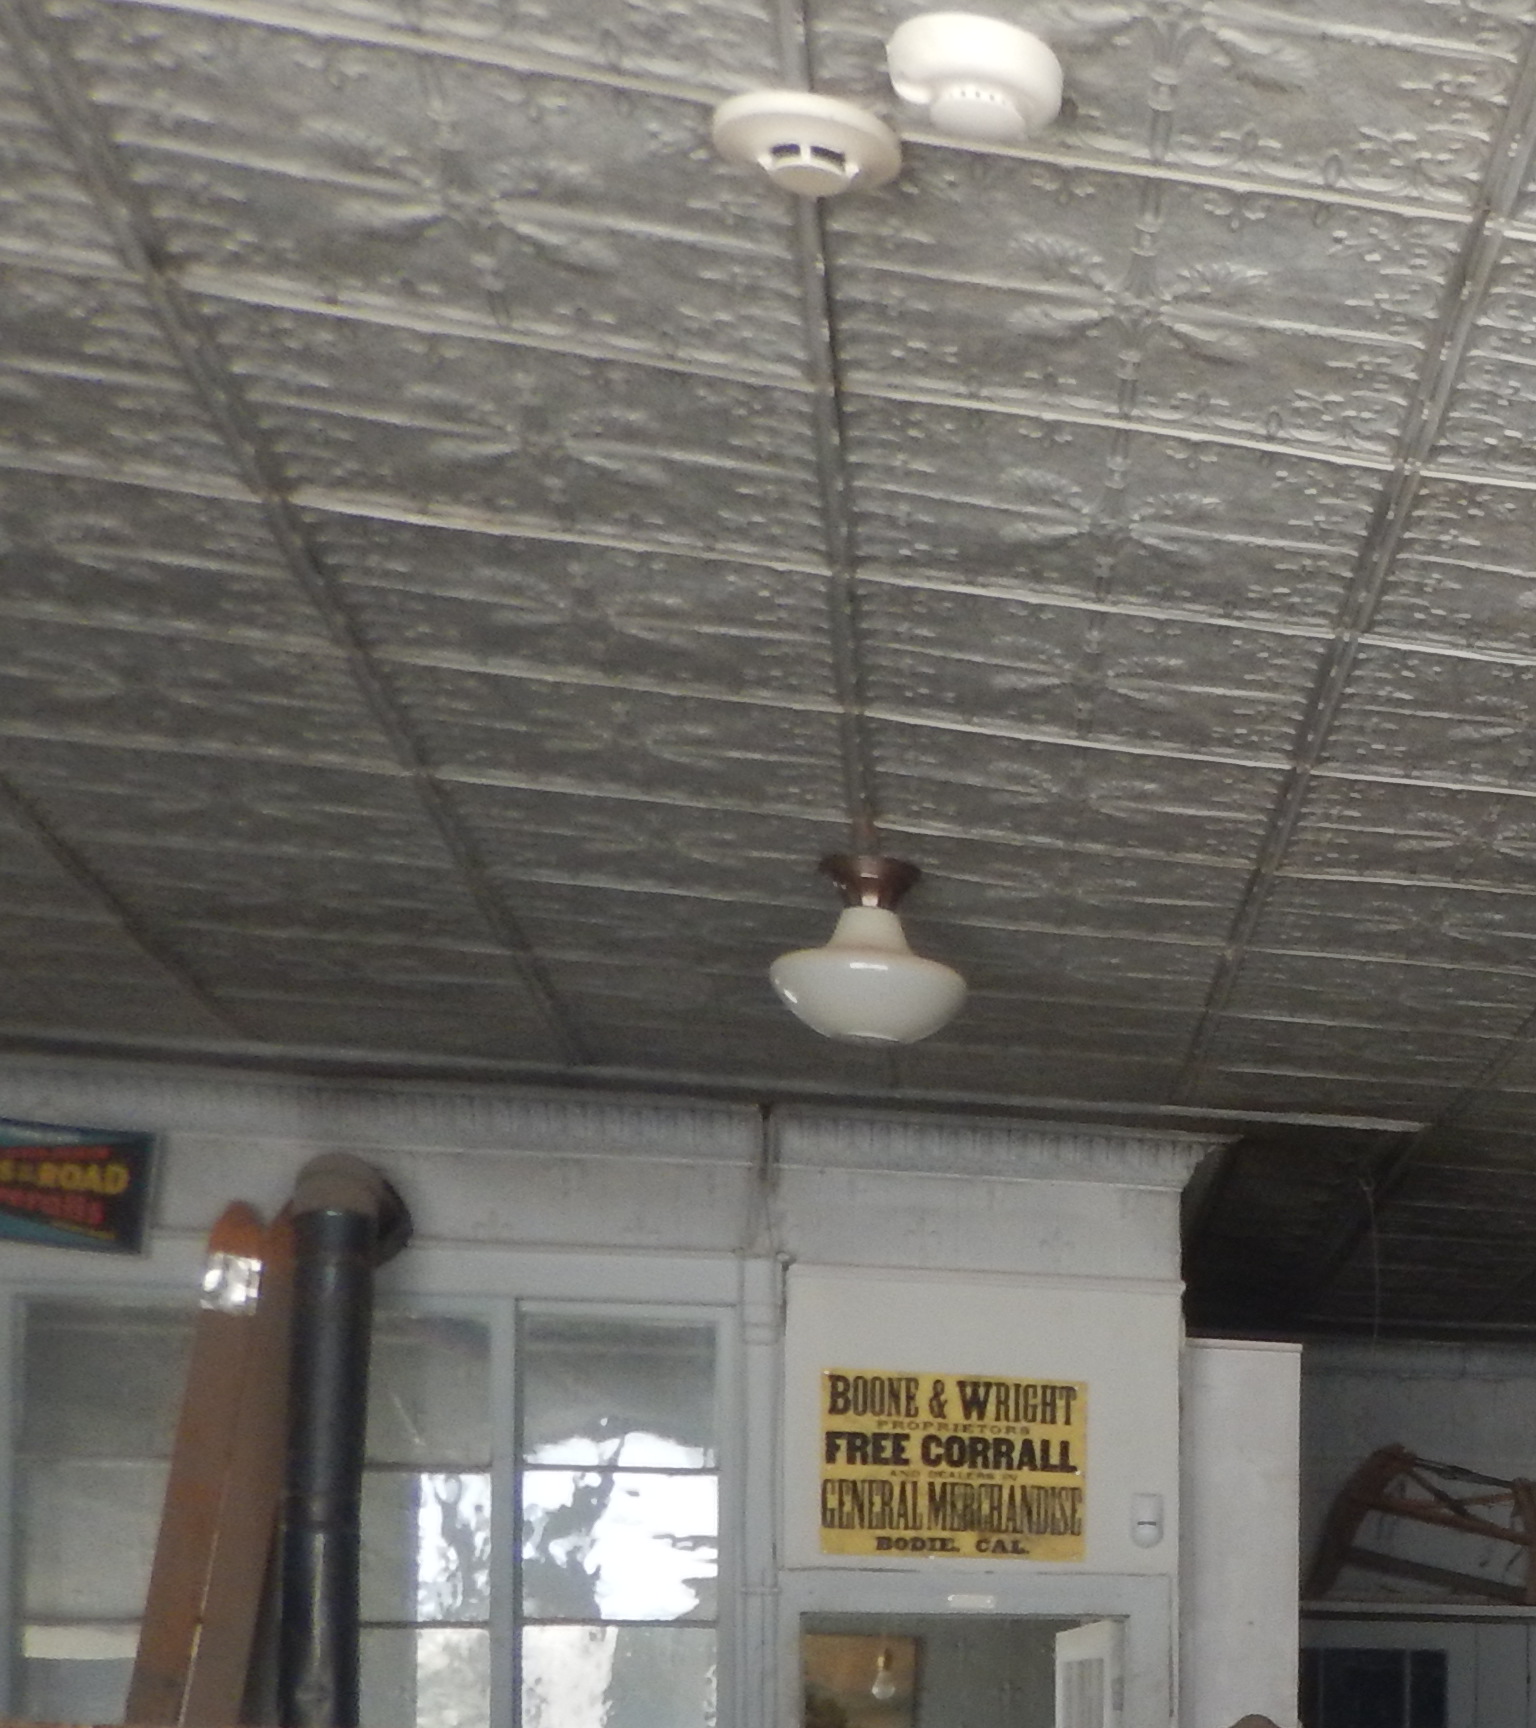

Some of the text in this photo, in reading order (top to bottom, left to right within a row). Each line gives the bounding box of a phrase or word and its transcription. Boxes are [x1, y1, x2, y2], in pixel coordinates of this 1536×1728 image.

[828, 1374, 1078, 1426] BOONE & WRIGHT
[876, 1420, 1030, 1436] PROPRIETORS
[825, 1431, 1079, 1473] FREE CORRALL
[890, 1469, 921, 1479] AND
[928, 1470, 996, 1481] DEALERS
[821, 1478, 1082, 1537] GENERAL MERCHANDISE
